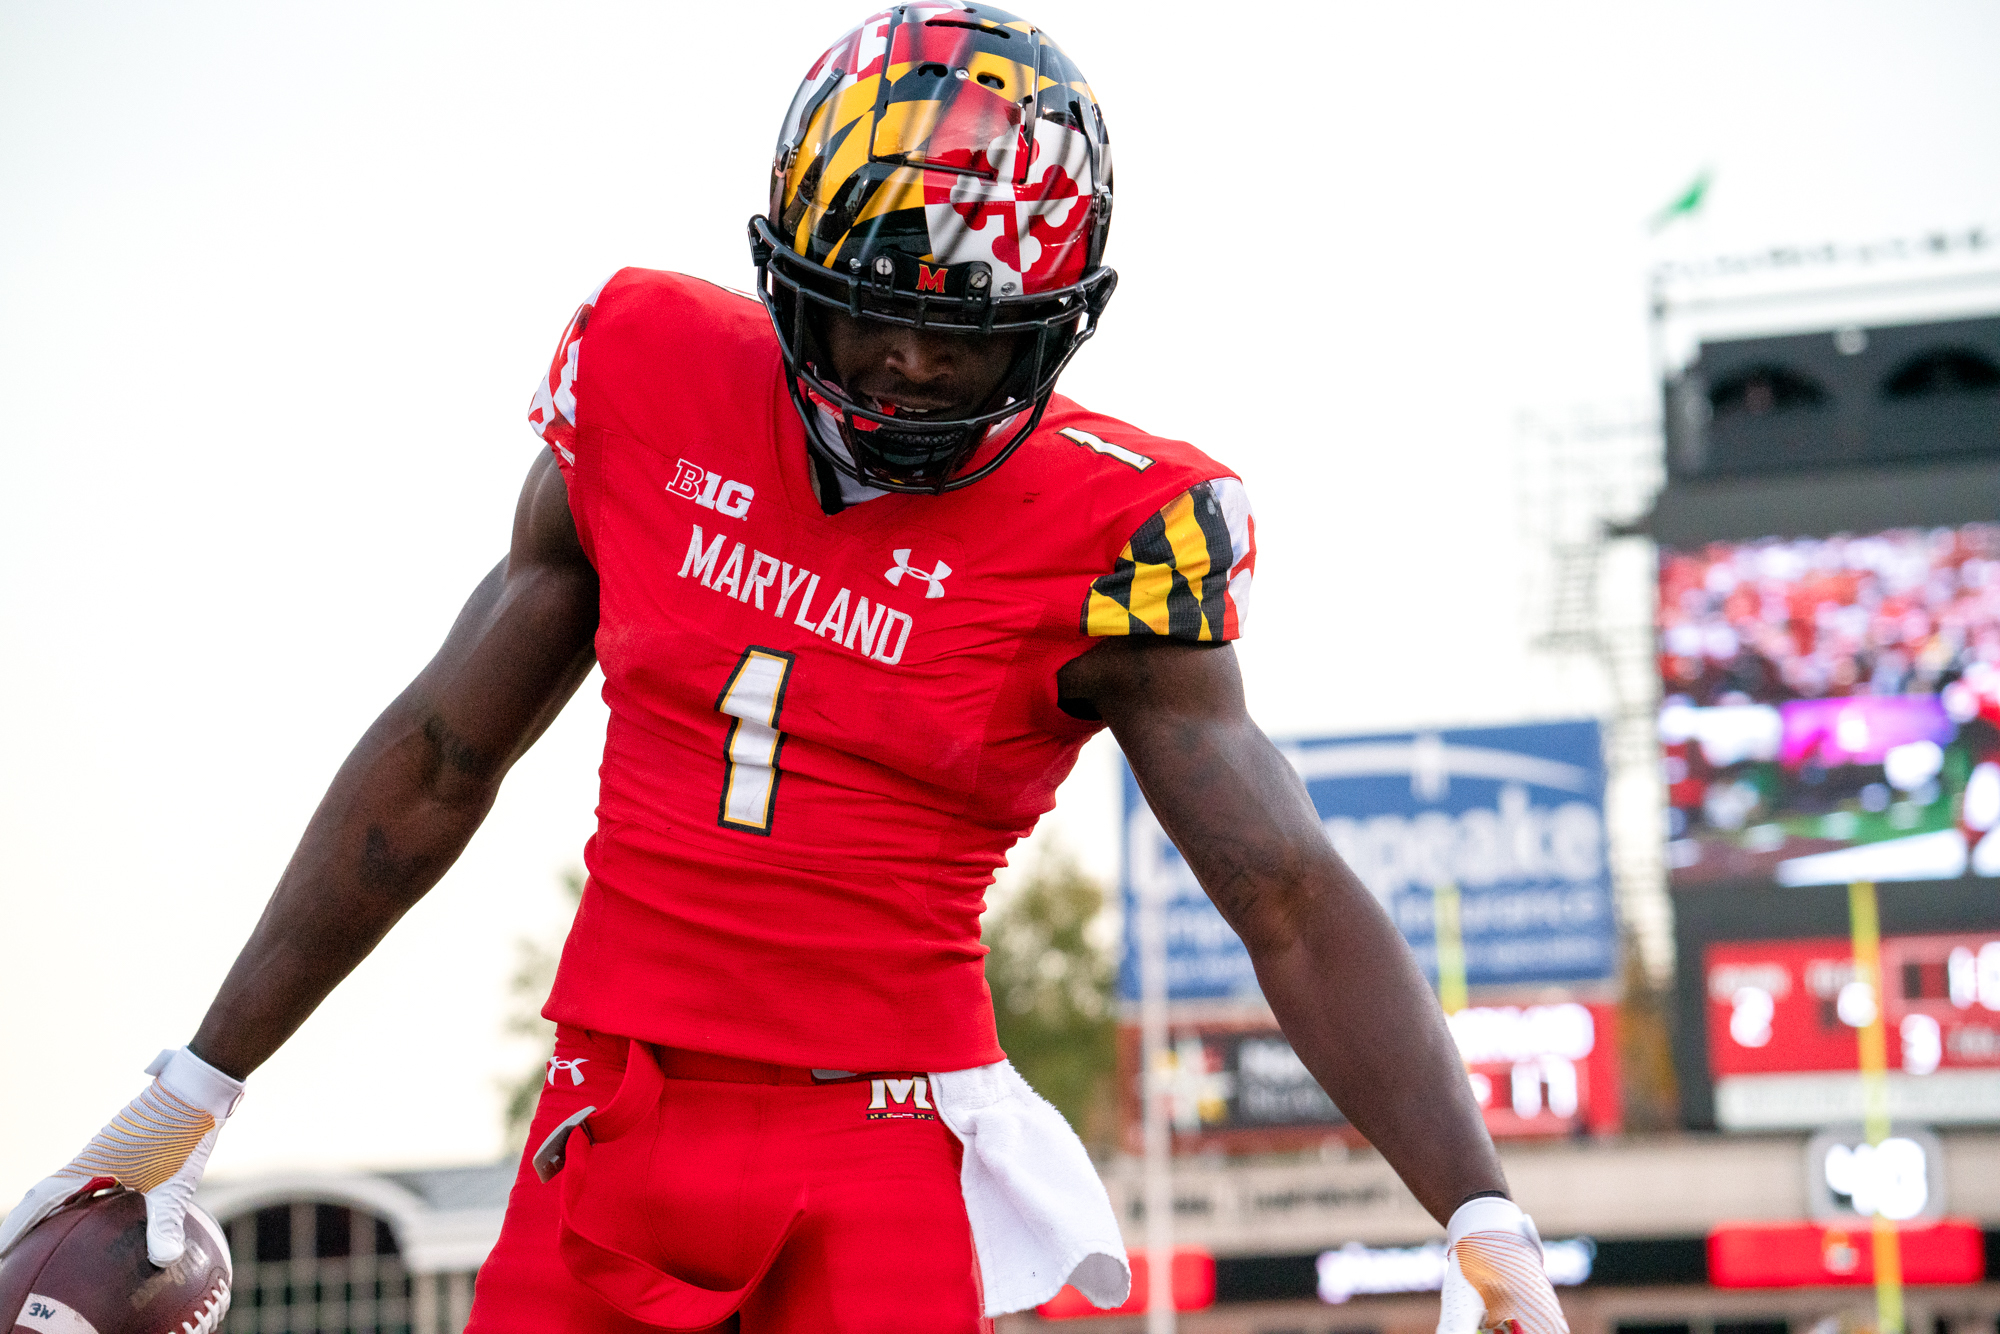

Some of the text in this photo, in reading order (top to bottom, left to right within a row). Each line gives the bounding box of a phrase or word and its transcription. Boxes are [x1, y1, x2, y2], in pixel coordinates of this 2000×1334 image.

[915, 264, 949, 294] M
[1056, 427, 1157, 474] 1
[677, 524, 913, 666] MARYLAND
[714, 644, 796, 837] 1
[866, 1076, 935, 1111] M
